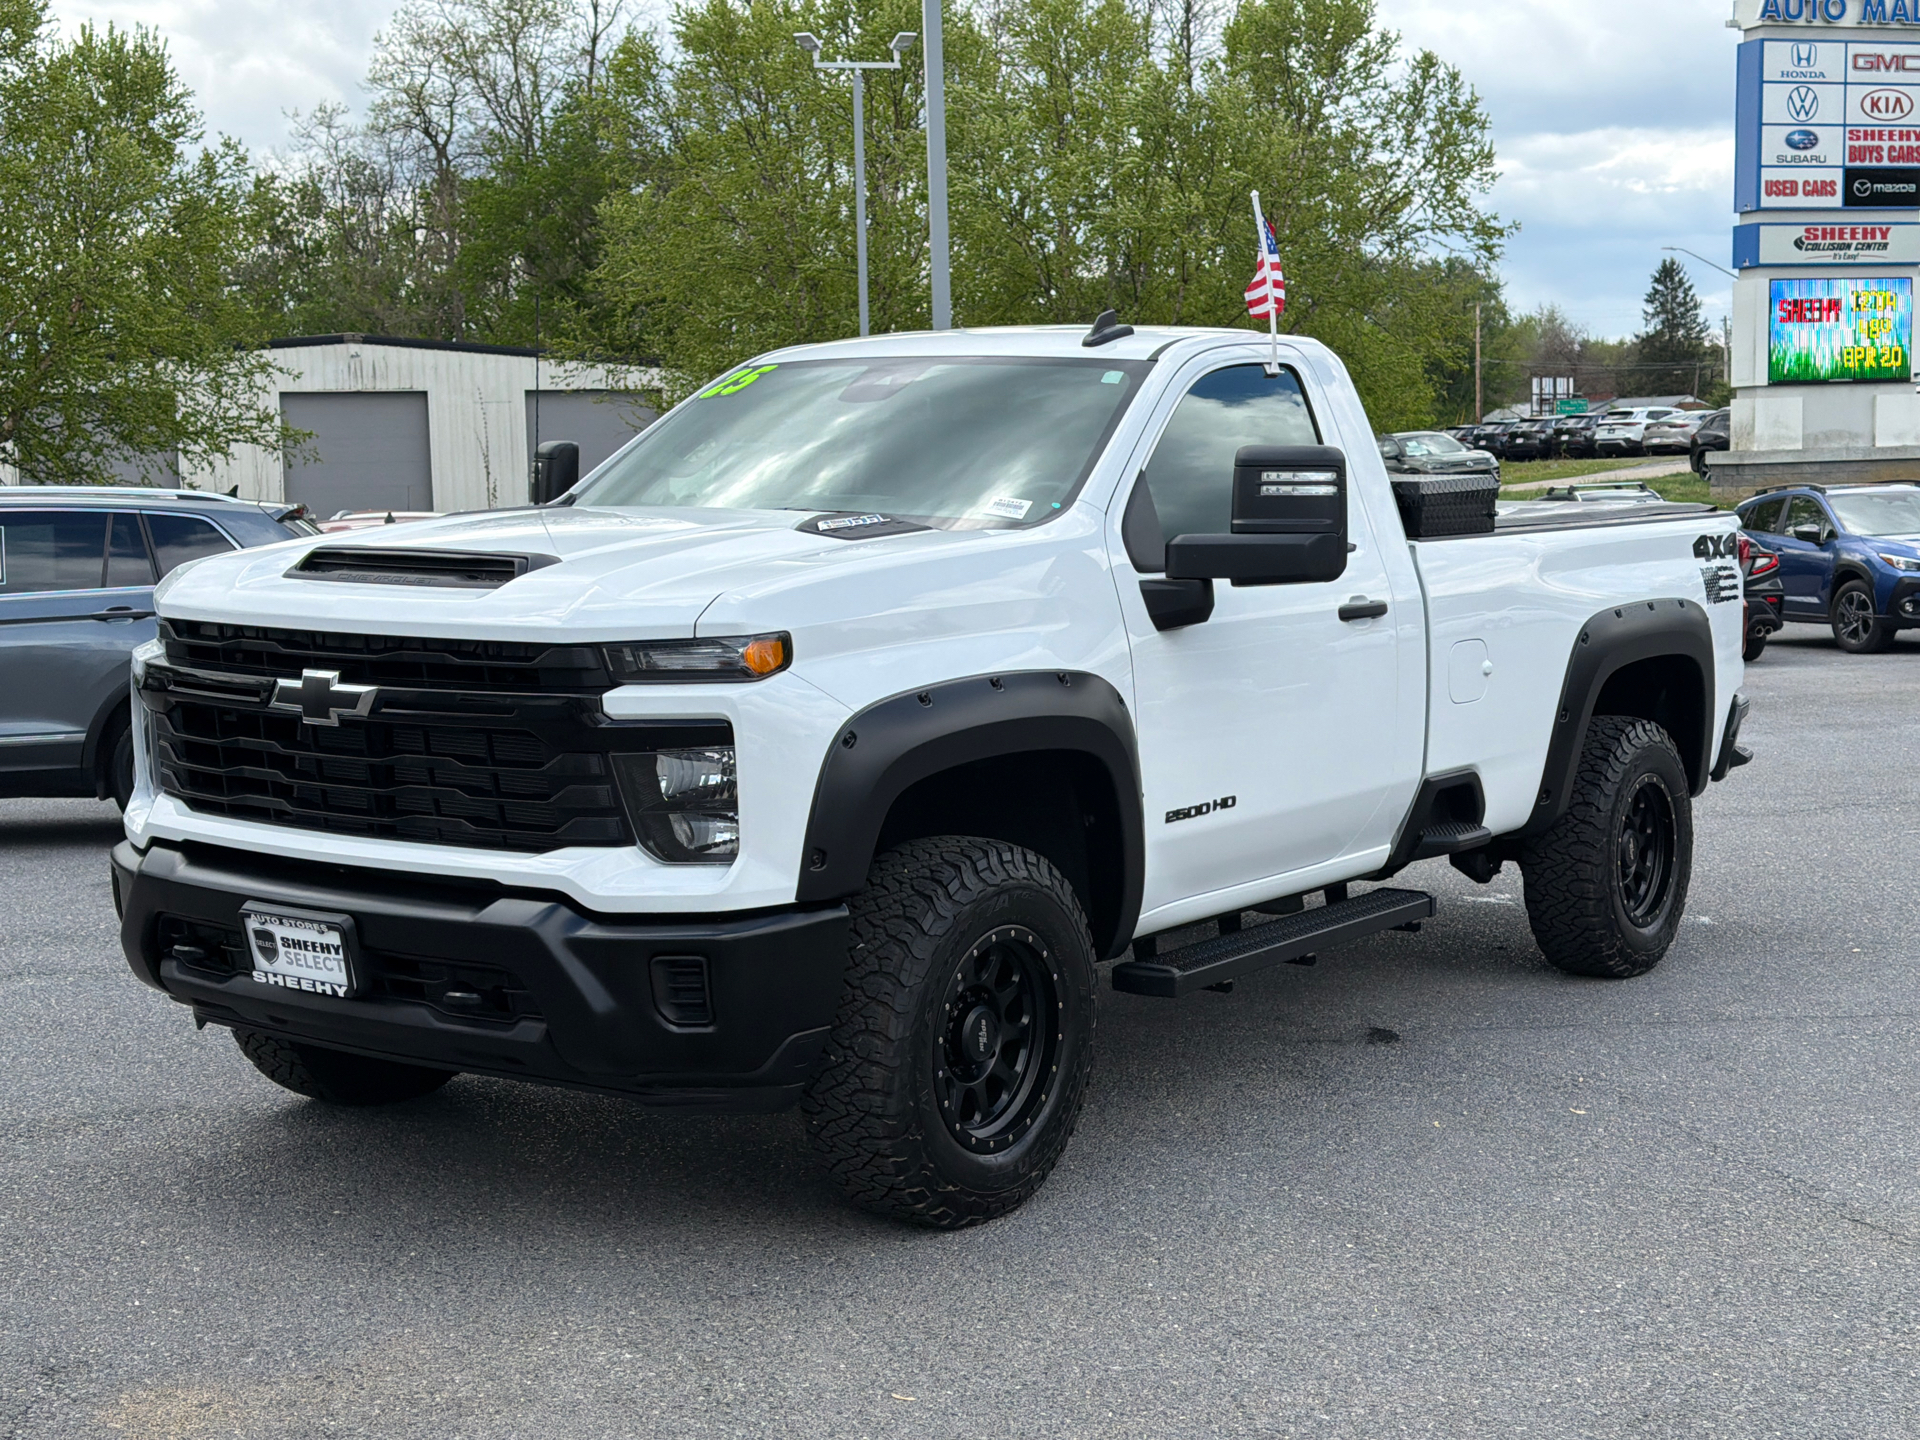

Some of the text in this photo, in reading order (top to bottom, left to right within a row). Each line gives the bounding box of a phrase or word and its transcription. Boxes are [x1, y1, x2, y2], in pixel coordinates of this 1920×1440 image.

[1760, 0, 1847, 21] AUTO
[1852, 53, 1920, 72] GMC
[1780, 70, 1826, 79] HONDA
[1869, 96, 1905, 114] KIA
[1848, 129, 1920, 142] SHEEHY
[1776, 154, 1827, 164] SUBARU
[1848, 144, 1885, 163] BUYS
[1764, 180, 1837, 197] USED CARS
[1873, 183, 1916, 193] mazda
[1804, 226, 1892, 241] SHEEHY
[1804, 241, 1890, 252] COLLISION CENTER
[1778, 298, 1842, 323] SHEEHY
[1844, 345, 1902, 368] APR 20
[337, 573, 438, 585] CHEVROLET
[1212, 795, 1237, 812] HD
[250, 914, 329, 932] AUTO STORES
[255, 939, 277, 949] SELECT
[279, 936, 342, 956] SHEEHY
[284, 950, 344, 973] SELECT
[252, 970, 348, 998] SHEEHY
